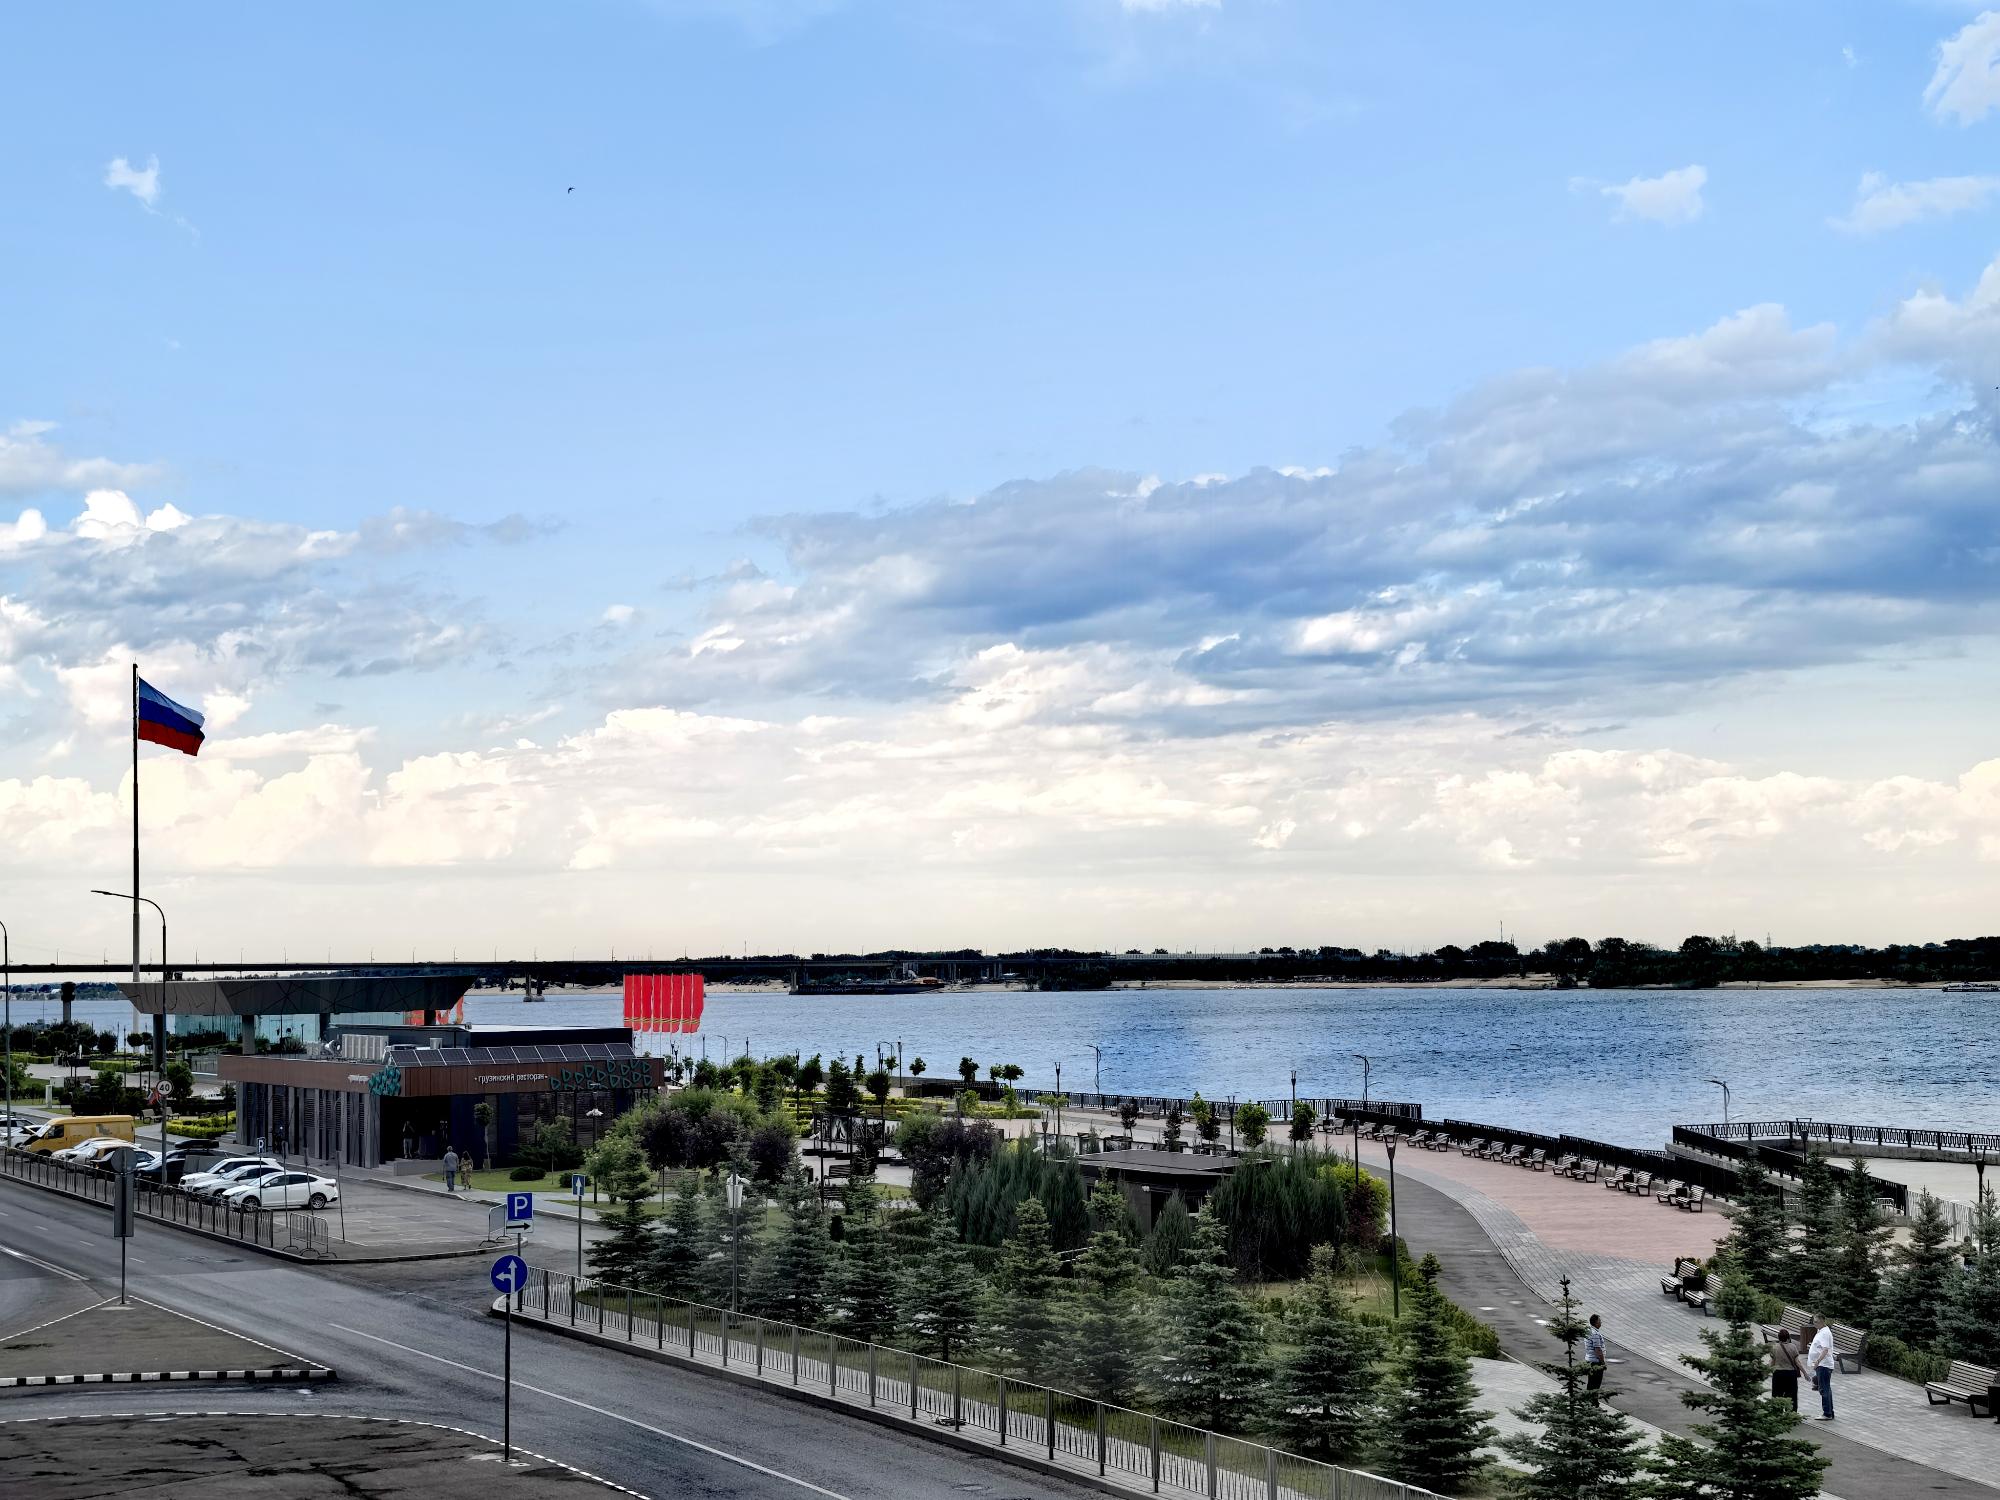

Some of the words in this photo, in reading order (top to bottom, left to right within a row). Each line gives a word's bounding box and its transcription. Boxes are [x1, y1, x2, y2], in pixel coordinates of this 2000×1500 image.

[478, 1073, 515, 1084] грузинский
[516, 1073, 545, 1084] ресторан
[159, 1083, 170, 1091] 40
[514, 1196, 528, 1217] P
